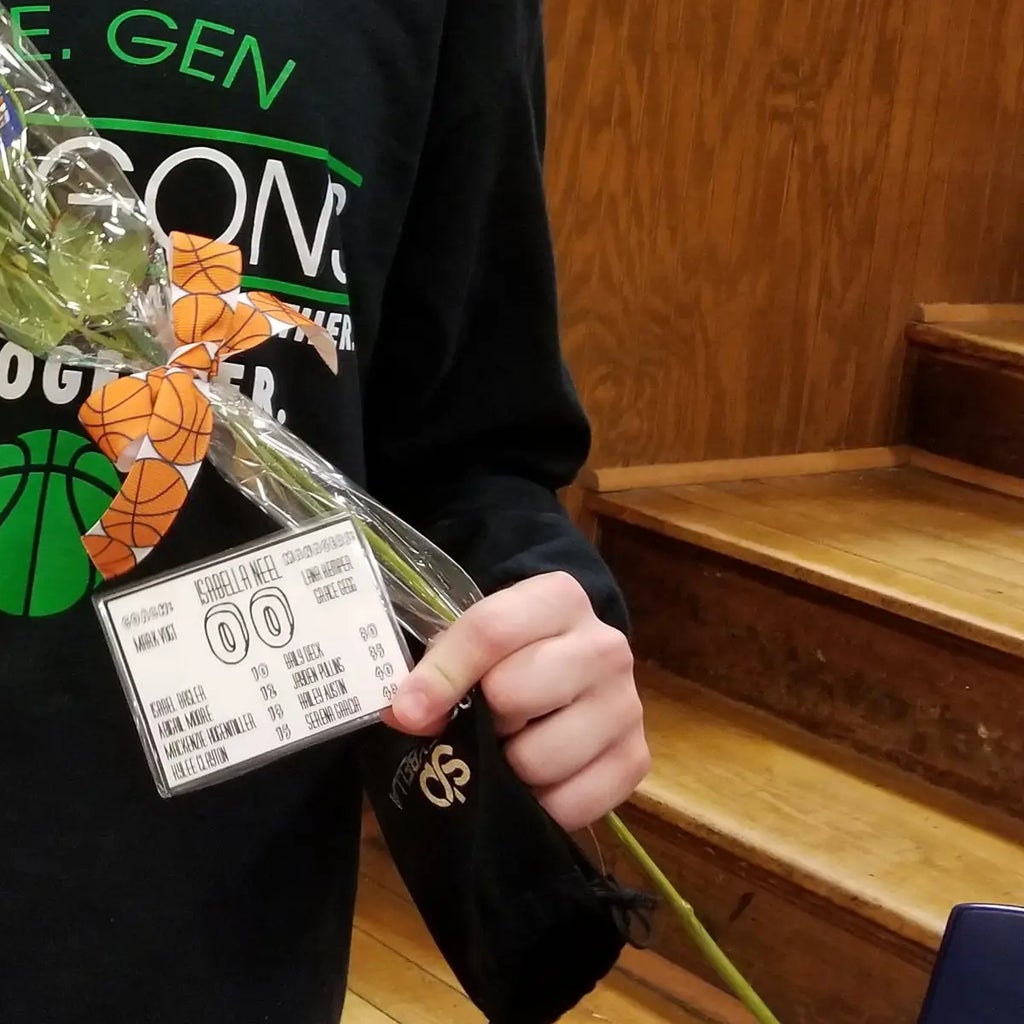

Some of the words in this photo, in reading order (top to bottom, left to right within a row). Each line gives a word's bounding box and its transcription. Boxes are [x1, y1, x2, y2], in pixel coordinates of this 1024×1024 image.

[107, 9, 296, 110] GEN
[194, 564, 253, 606] ISABELLA
[249, 555, 283, 586] NEEL
[204, 586, 295, 664] 00
